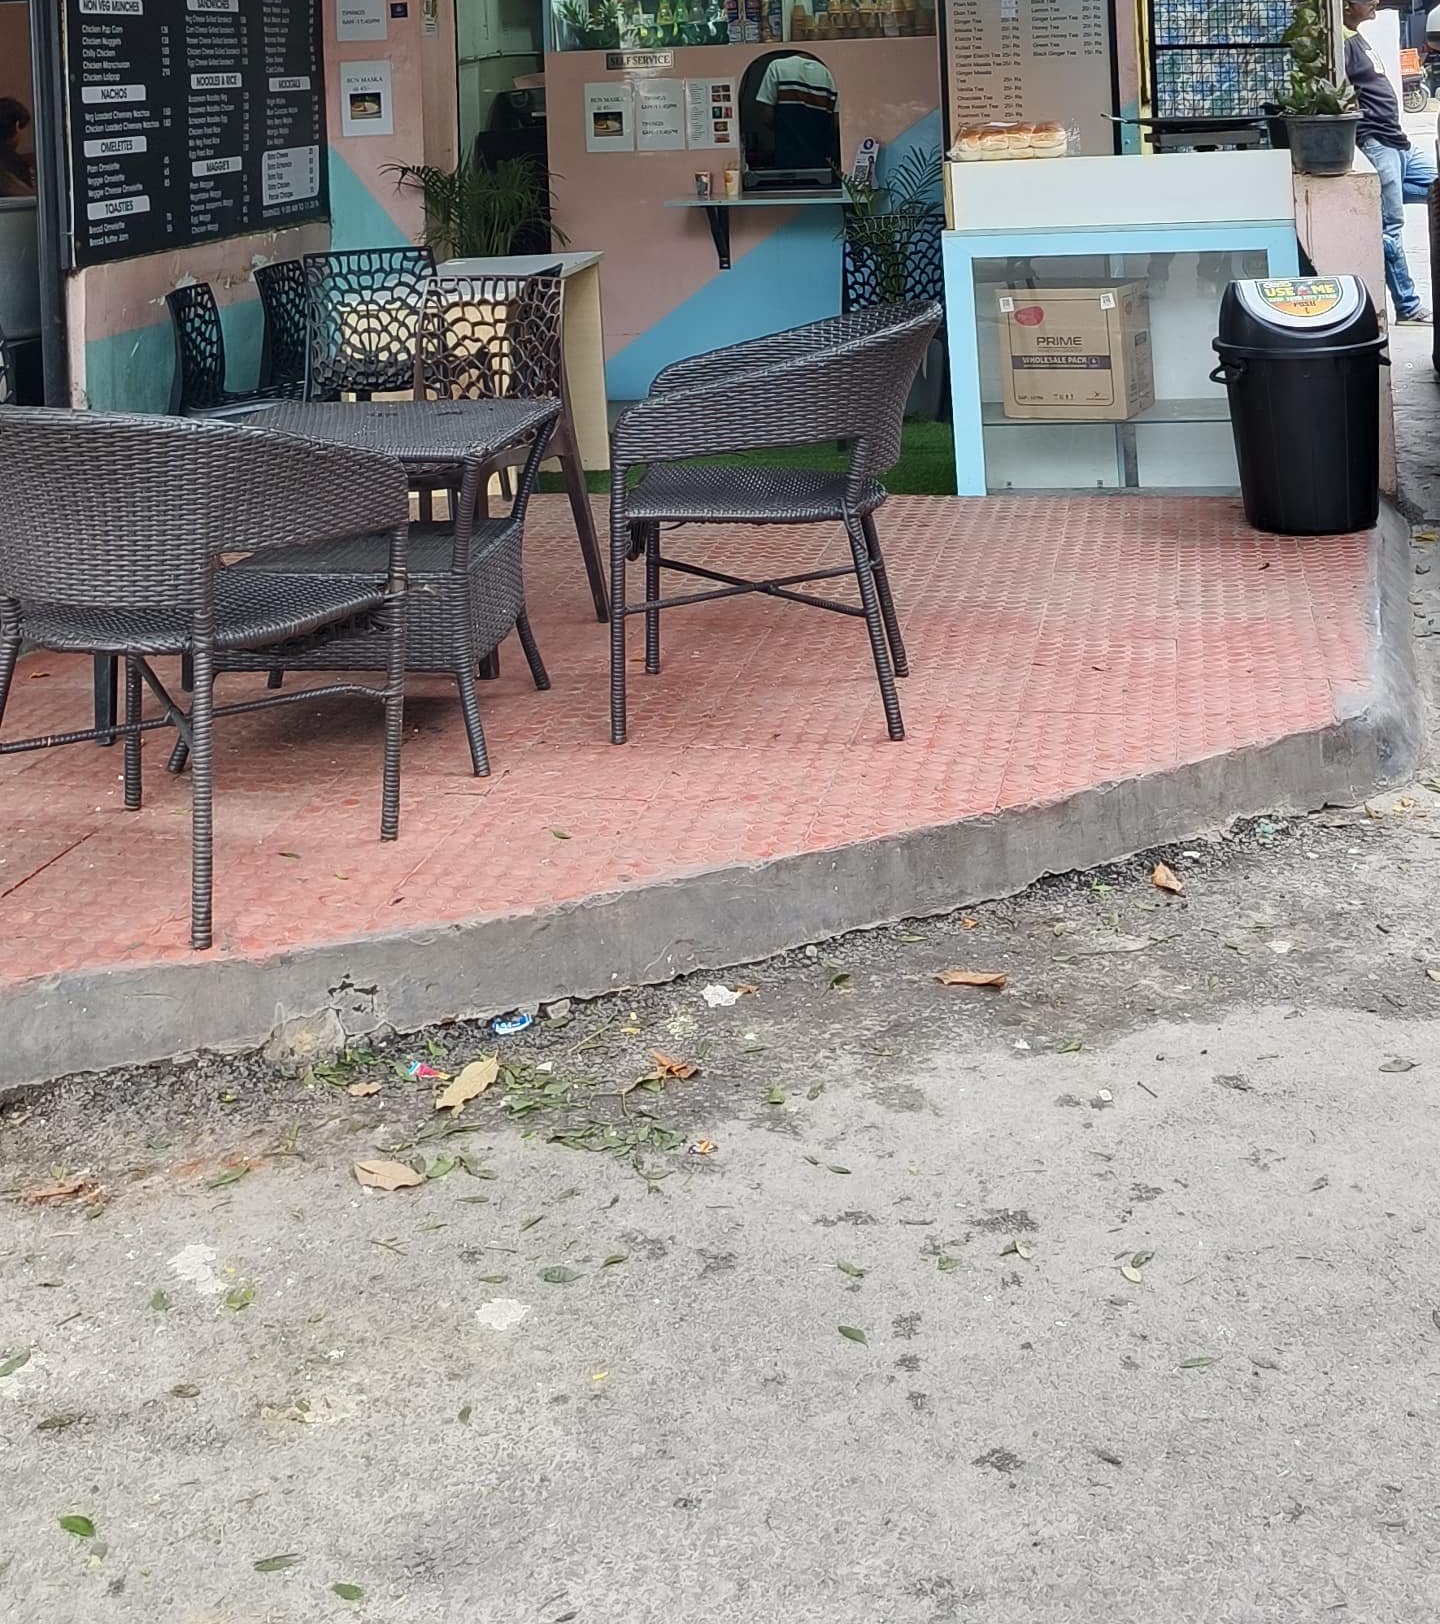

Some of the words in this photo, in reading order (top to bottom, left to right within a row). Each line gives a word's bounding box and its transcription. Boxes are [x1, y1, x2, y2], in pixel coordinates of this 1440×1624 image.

[83, 0, 98, 11] NON
[98, 0, 111, 11] VEG
[112, 0, 140, 12] MUNCHES
[610, 56, 631, 66] SELF
[632, 55, 670, 65] SERVICE
[101, 88, 127, 100] NACHOS
[101, 140, 132, 152] OMELETTES
[105, 200, 133, 215] TOASTIES
[1264, 287, 1296, 297] USE
[1311, 284, 1336, 294] ME
[1036, 337, 1083, 346] PRIME
